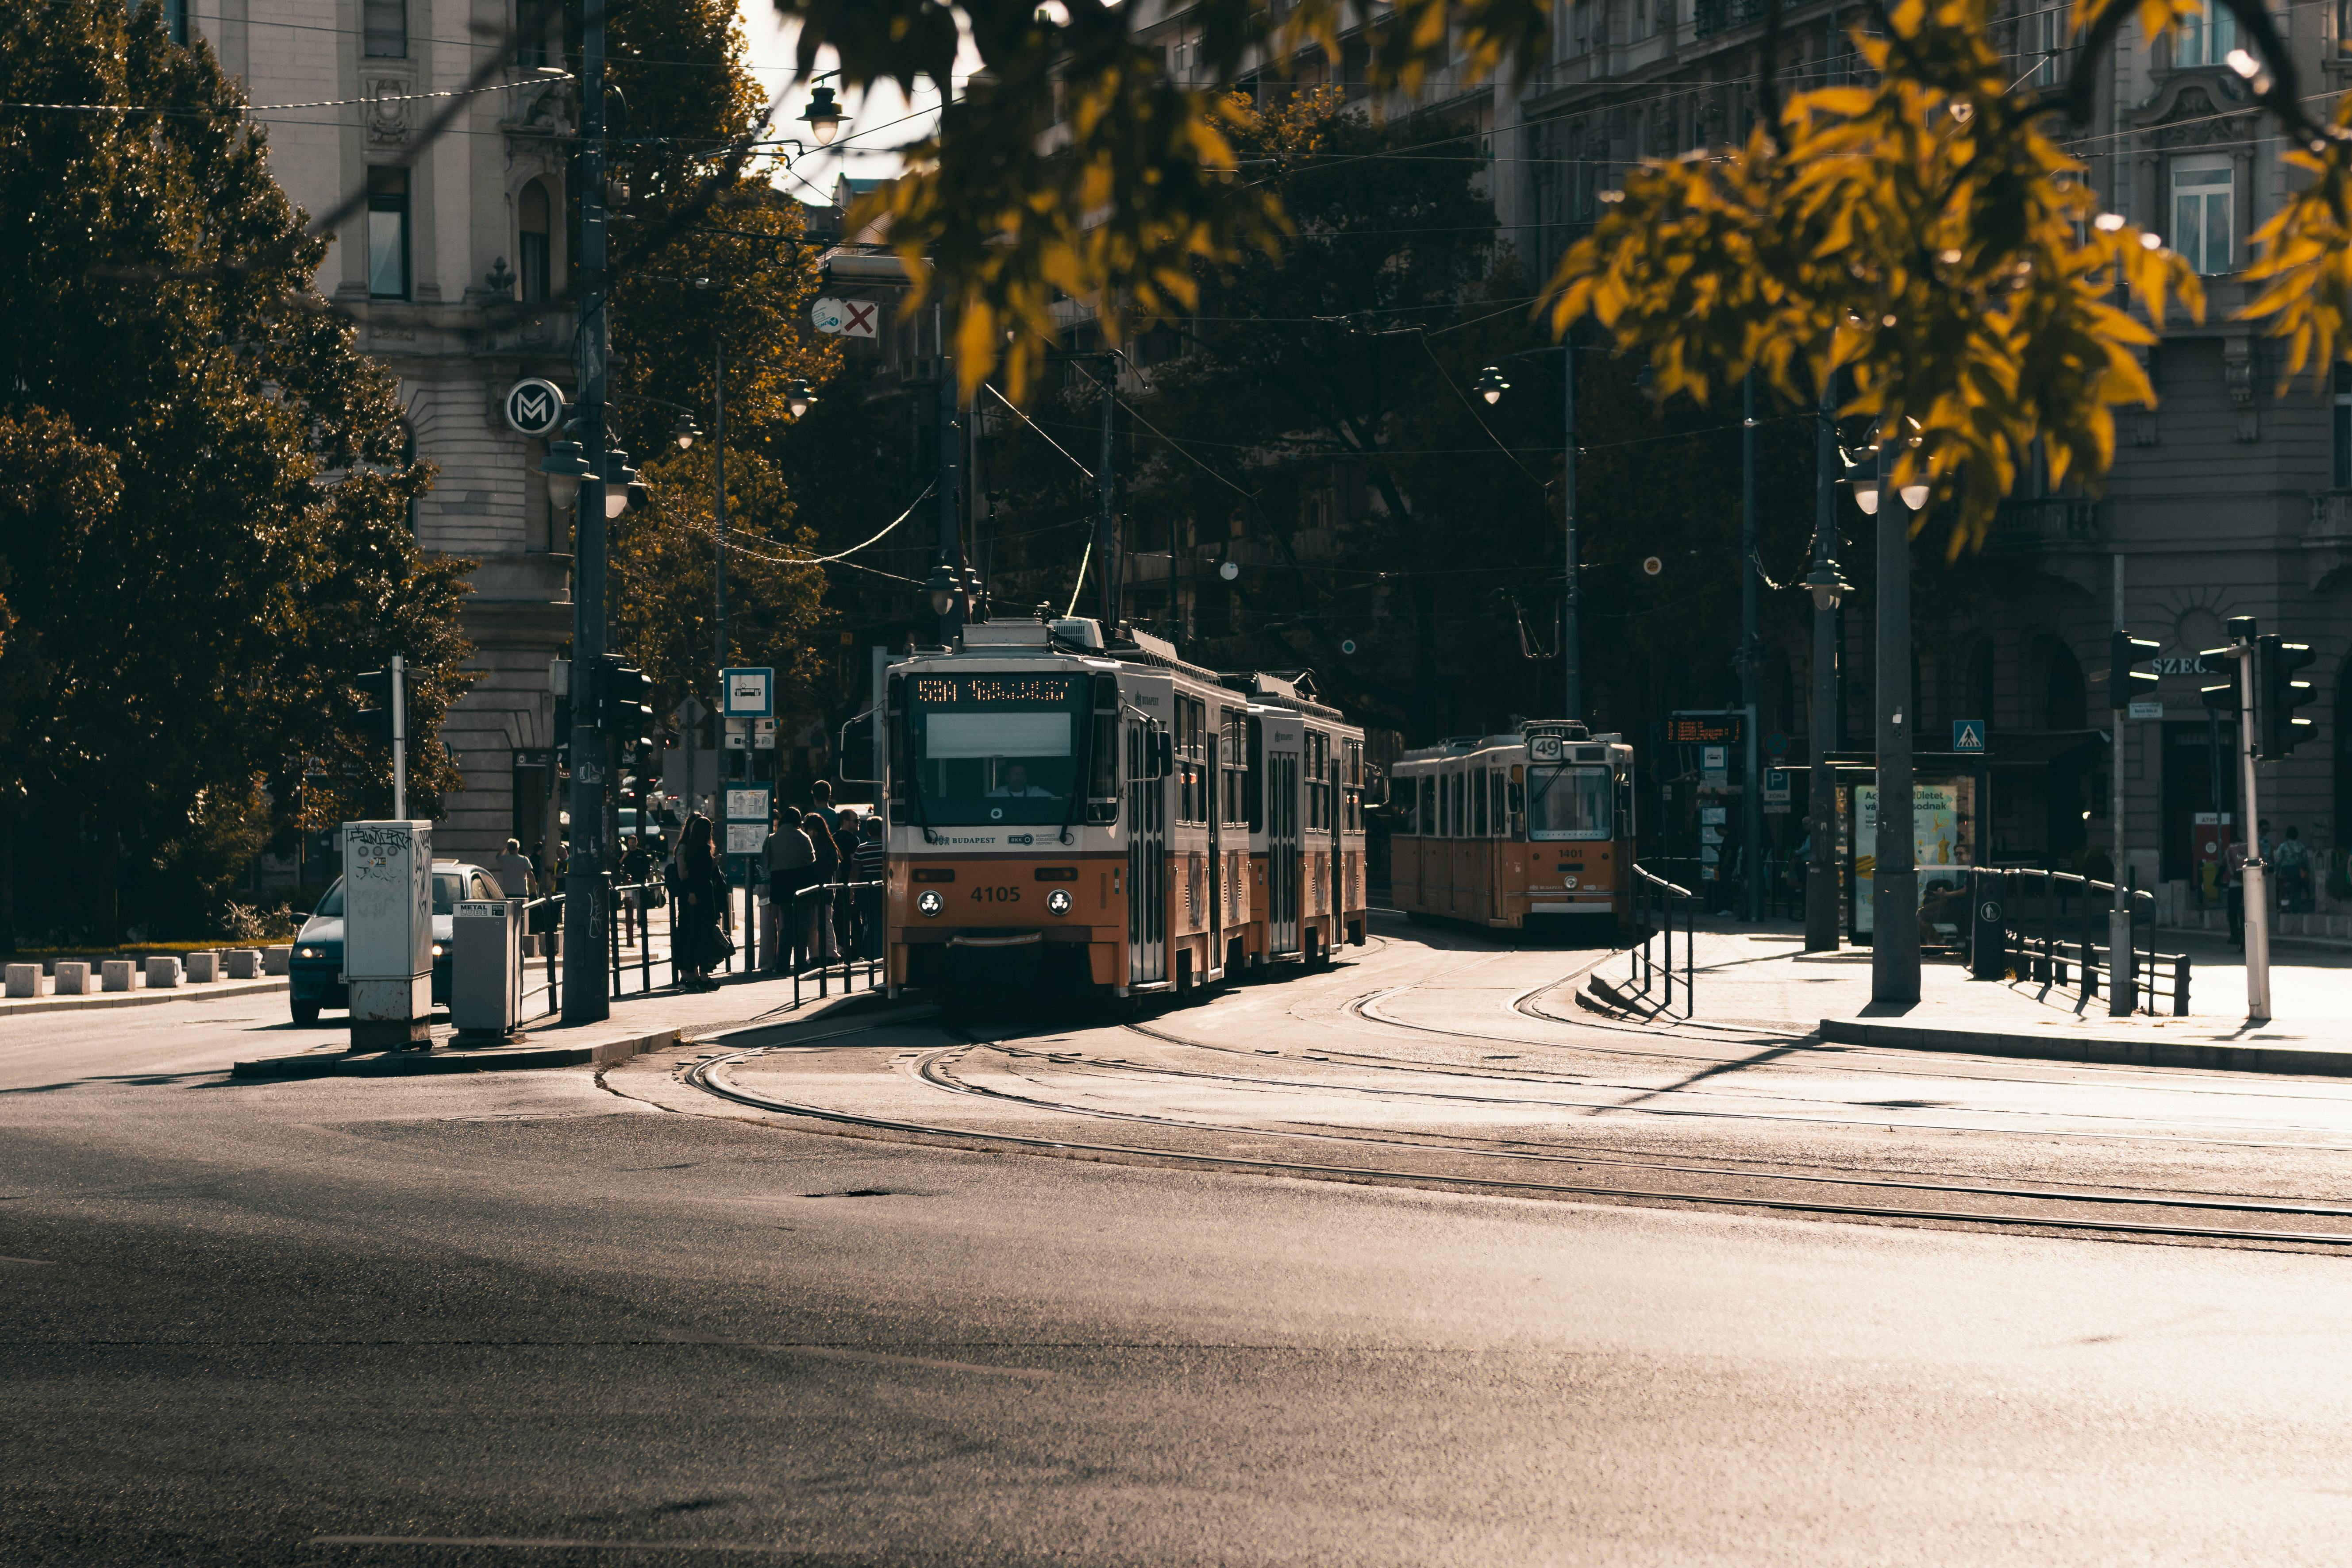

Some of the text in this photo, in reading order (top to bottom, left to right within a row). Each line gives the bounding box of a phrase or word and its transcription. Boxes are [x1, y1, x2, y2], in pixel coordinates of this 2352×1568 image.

[1536, 740, 1559, 755] 49
[1559, 849, 1582, 858] 1401
[970, 887, 1020, 902] 4105
